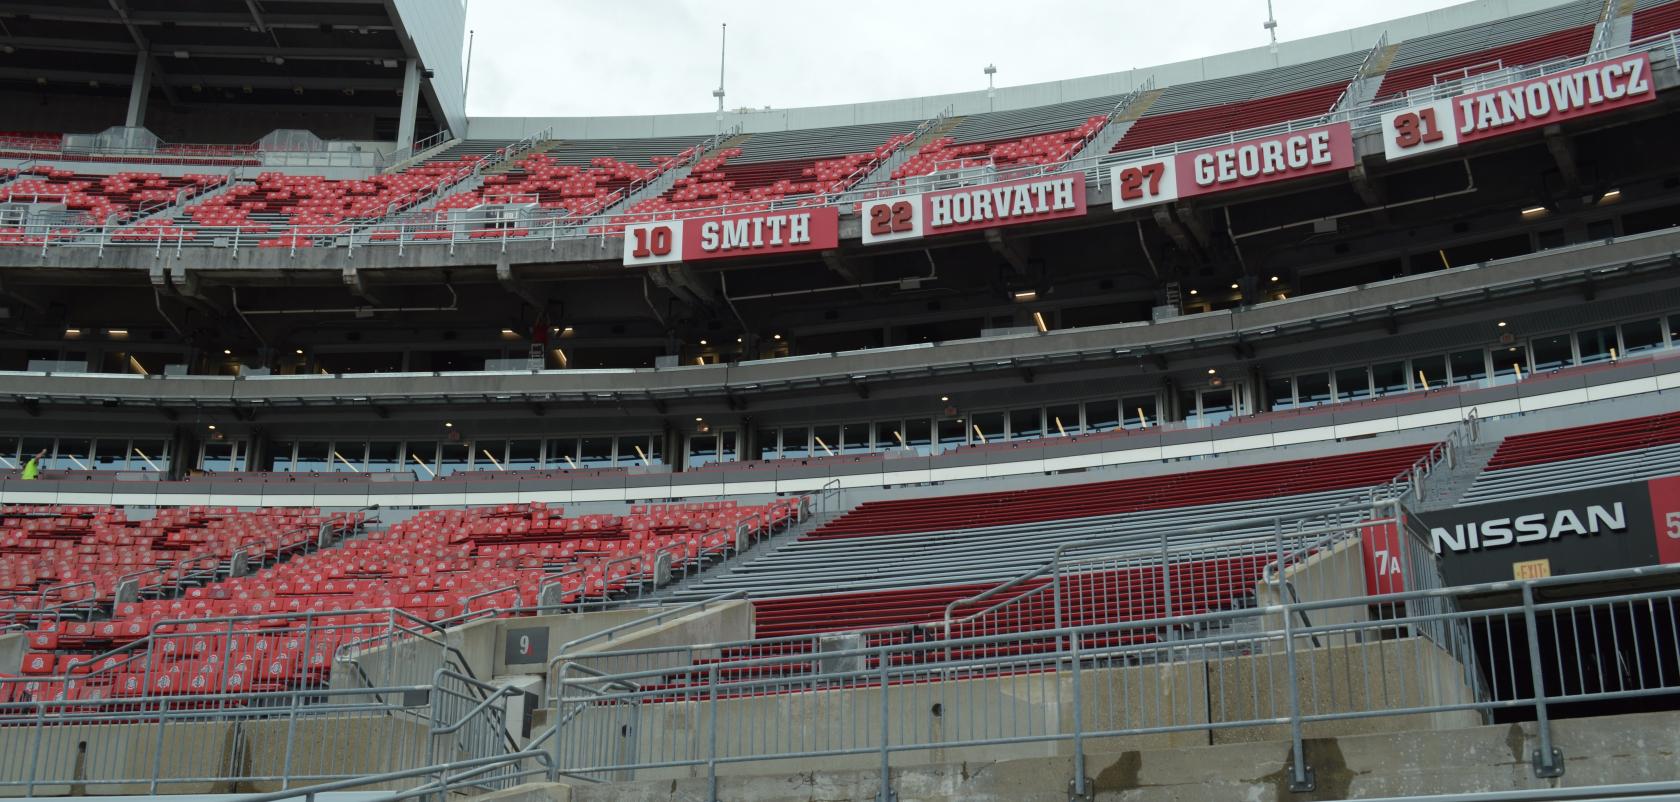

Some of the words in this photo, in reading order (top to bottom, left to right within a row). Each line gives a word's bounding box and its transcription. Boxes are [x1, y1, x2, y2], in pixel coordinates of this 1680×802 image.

[1393, 107, 1444, 148] 31
[1460, 58, 1649, 134] JANOWICZ
[1120, 162, 1165, 201] 27
[1194, 130, 1332, 187] GEORGE
[632, 225, 672, 258] 10
[701, 212, 811, 251] SMITH
[870, 201, 913, 236] 22
[930, 177, 1076, 228] HORVATH
[1430, 501, 1627, 554] NISSAN
